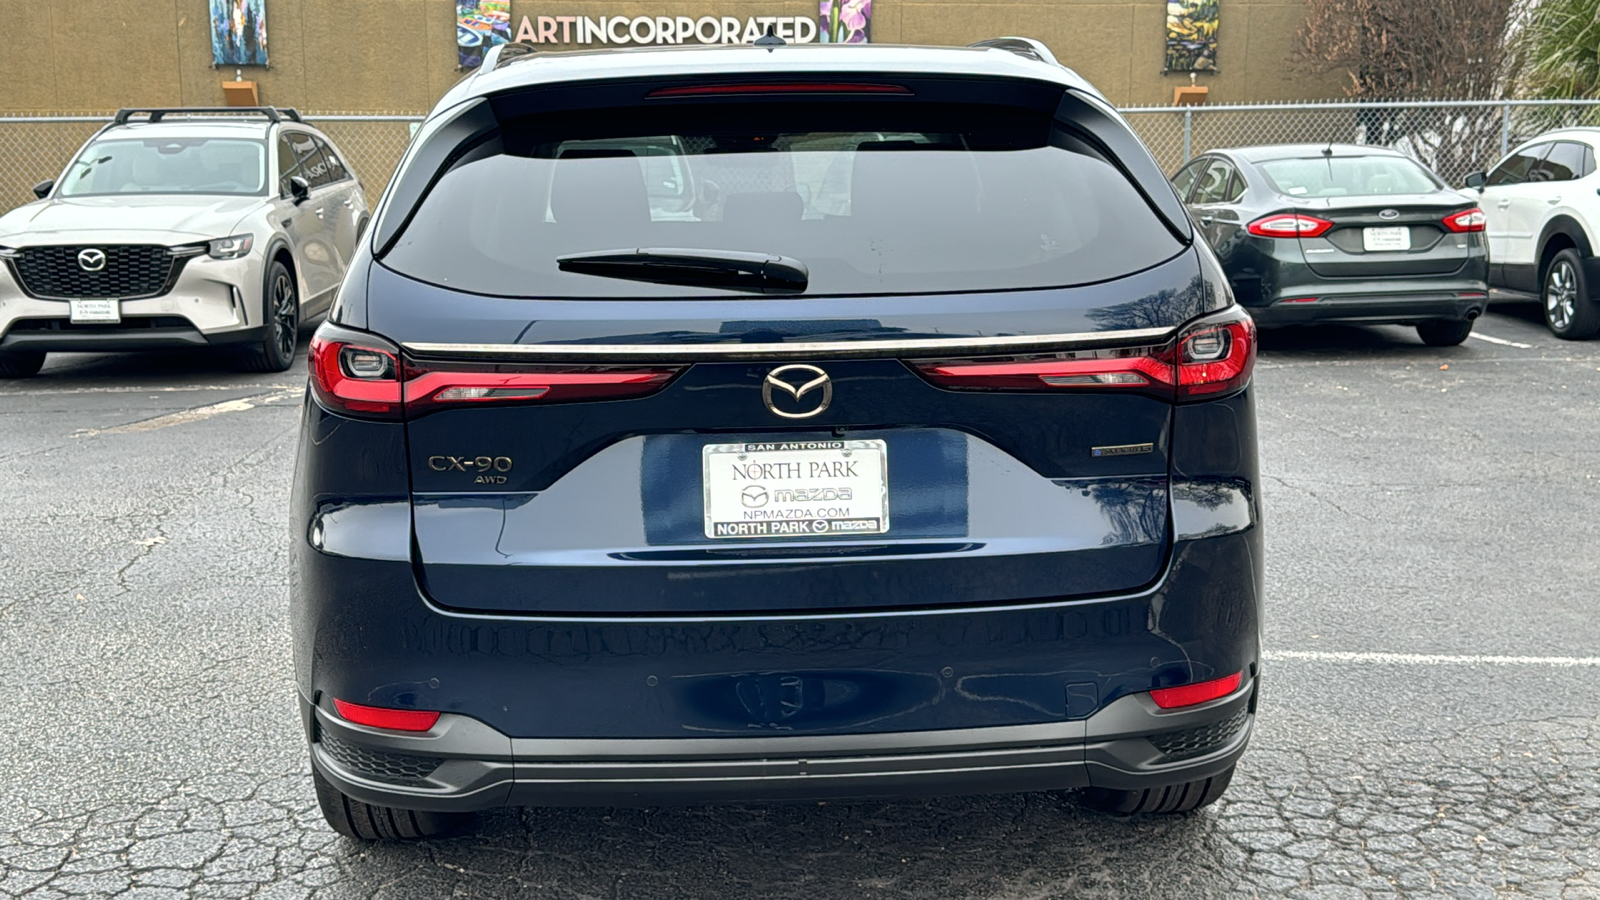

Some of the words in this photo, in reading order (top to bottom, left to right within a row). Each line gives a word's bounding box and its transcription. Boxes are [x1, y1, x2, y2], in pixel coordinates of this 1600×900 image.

[780, 442, 842, 450] ANTONIO
[428, 455, 513, 472] CX-90
[732, 461, 801, 480] NORTH
[809, 461, 859, 478] PARK
[474, 475, 507, 484] AWD
[774, 487, 852, 502] mazda
[743, 508, 850, 520] NPMAZDA.COM
[717, 522, 767, 536] NORTH
[771, 521, 810, 534] PARK
[831, 520, 878, 531] mazda
